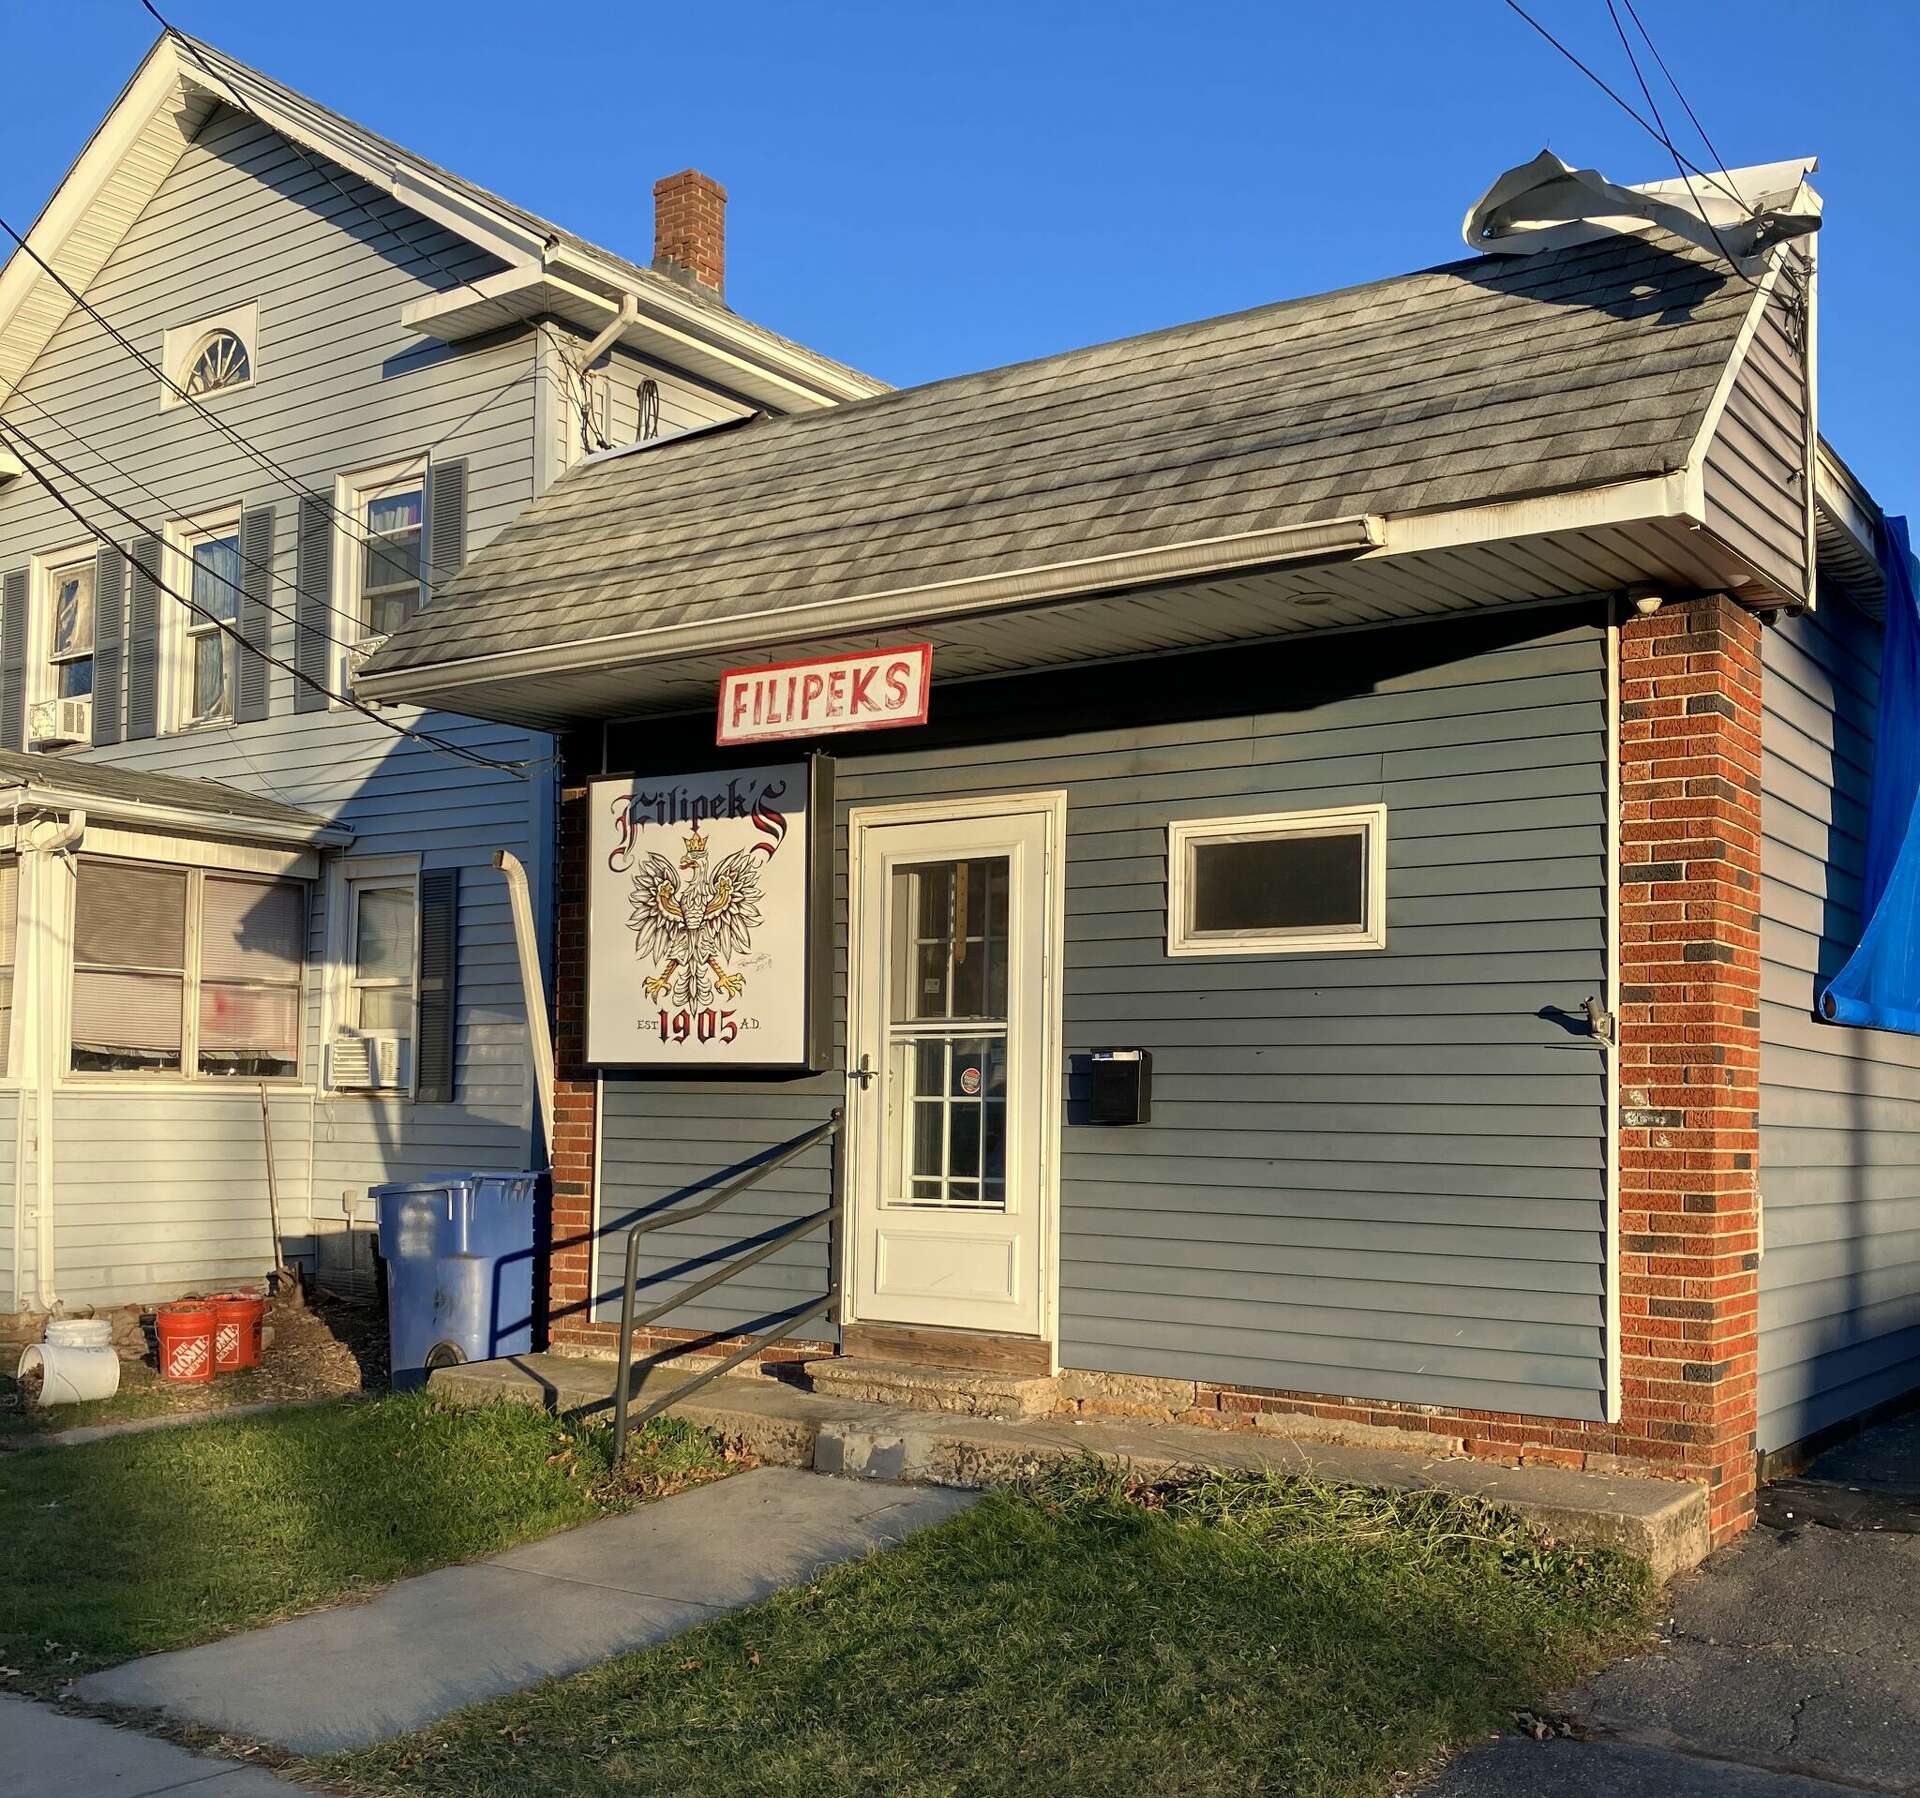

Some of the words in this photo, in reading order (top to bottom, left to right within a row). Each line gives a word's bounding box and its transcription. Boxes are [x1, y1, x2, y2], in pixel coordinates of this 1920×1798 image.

[732, 661, 911, 728] FILIPEKS
[637, 1019, 659, 1030] EST
[658, 1007, 738, 1045] 1905
[172, 1341, 191, 1357] THE
[216, 1325, 240, 1353] OME
[169, 1336, 208, 1377] HOME
[183, 1350, 209, 1376] DEPOT
